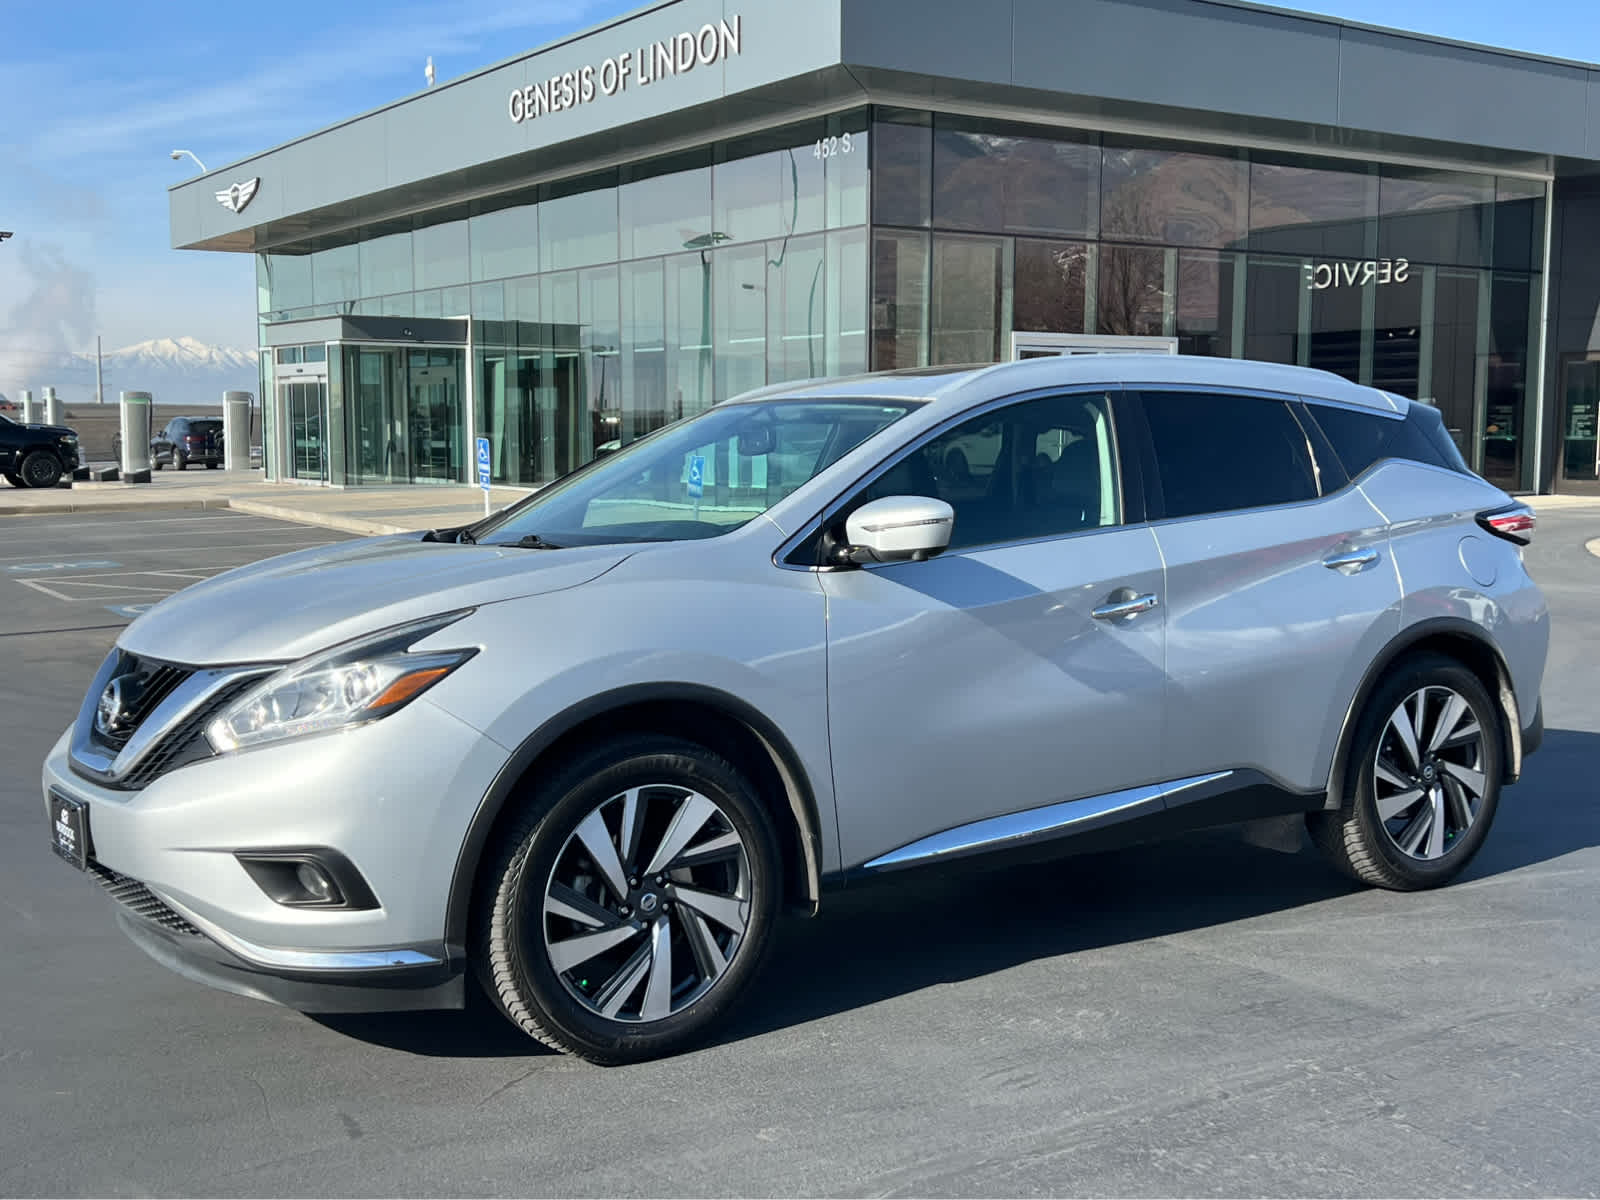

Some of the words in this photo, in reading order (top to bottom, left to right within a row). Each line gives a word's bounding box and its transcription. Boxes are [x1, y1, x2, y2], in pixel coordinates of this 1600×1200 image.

[508, 65, 596, 124] GENESIS
[599, 52, 632, 96] OF
[636, 15, 741, 86] LINDON
[814, 136, 837, 160] 452
